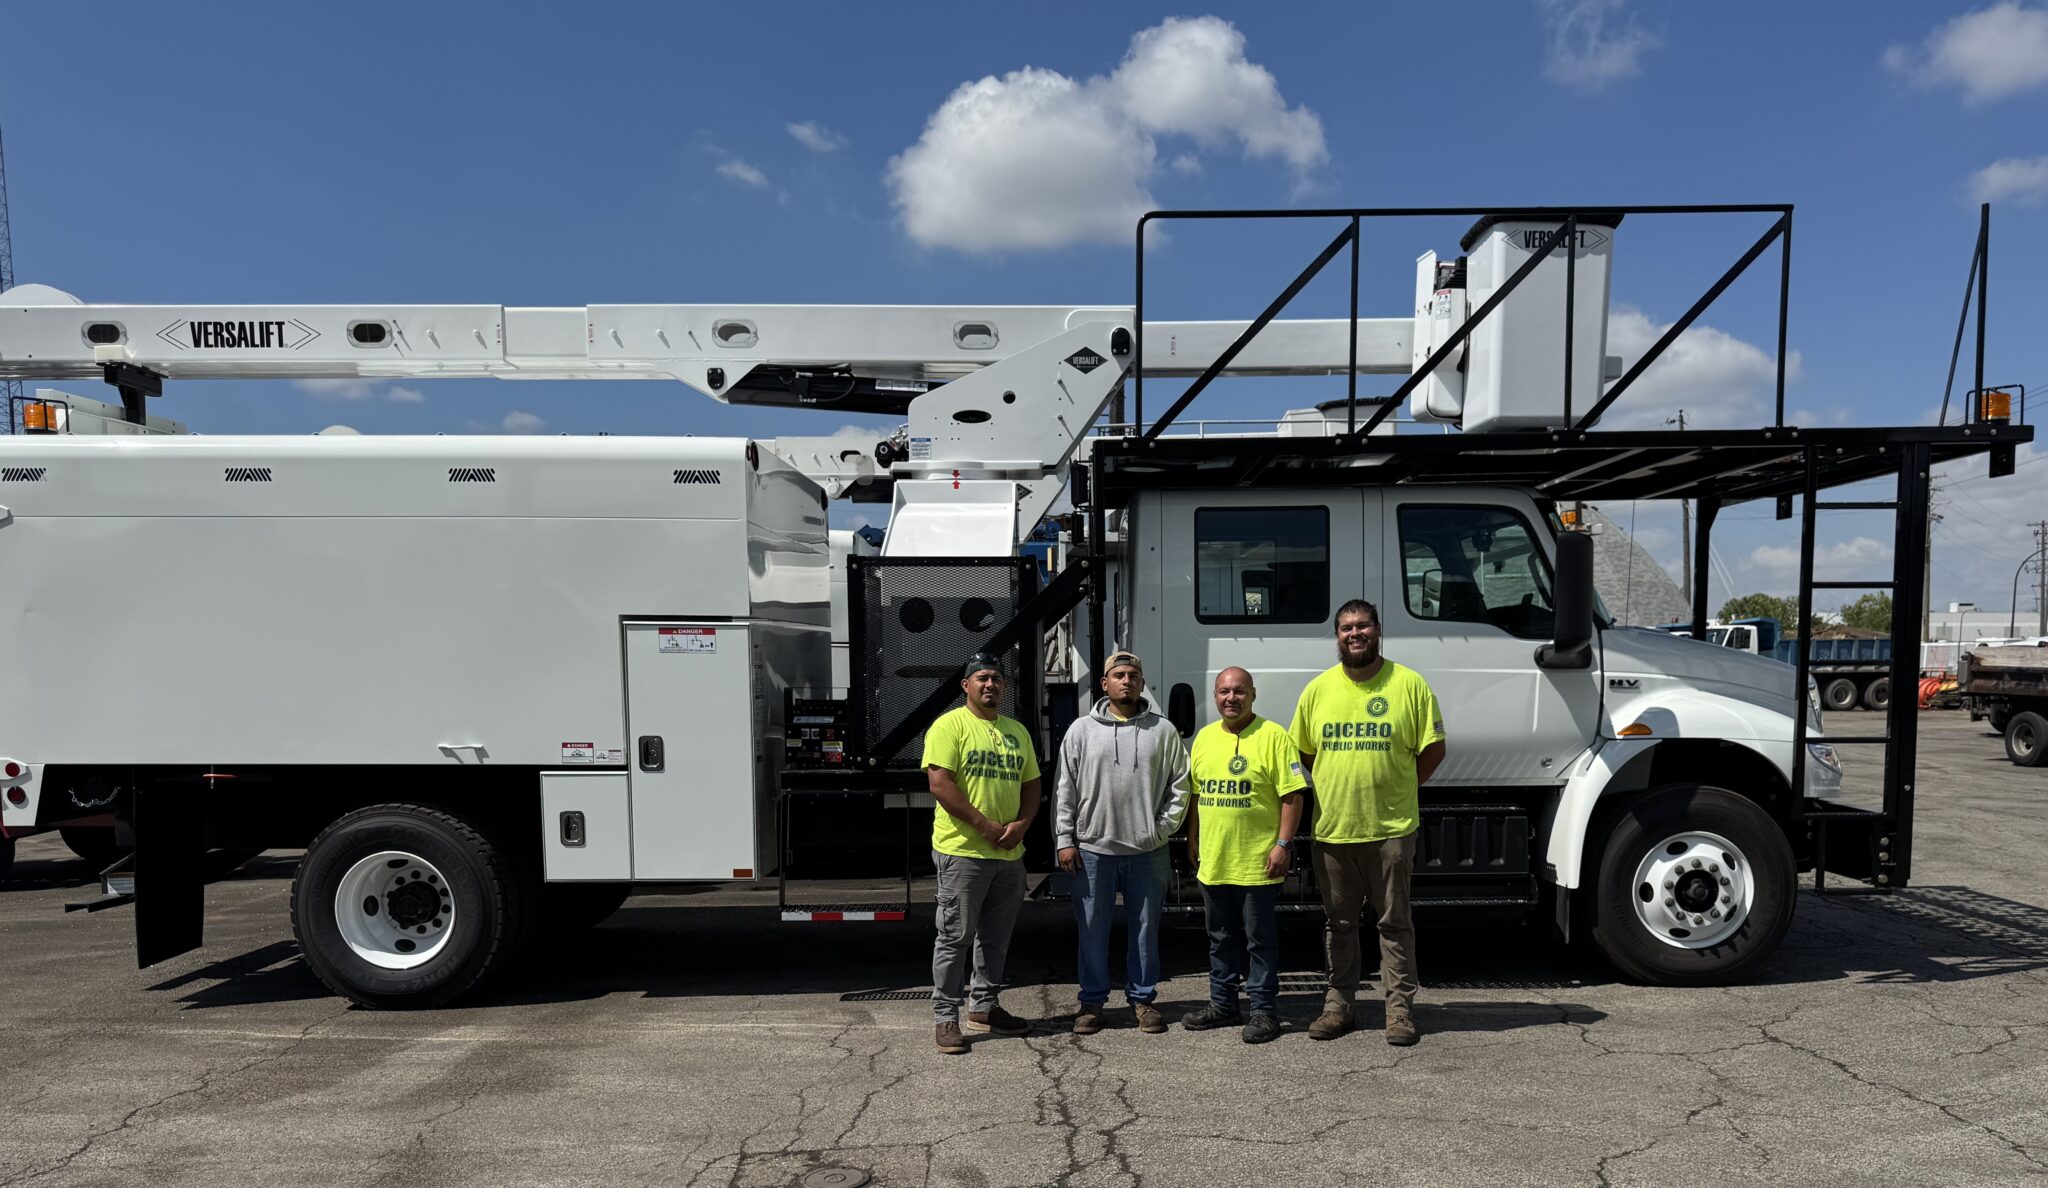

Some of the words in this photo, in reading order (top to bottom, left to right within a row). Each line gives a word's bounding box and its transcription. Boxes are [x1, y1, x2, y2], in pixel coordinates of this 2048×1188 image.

[1524, 230, 1586, 249] VERSLT
[190, 321, 285, 349] VERSALIFT
[1072, 356, 1099, 365] VERSALIFT
[1609, 679, 1640, 687] HV
[1322, 722, 1392, 738] CICERO
[1322, 741, 1353, 751] PUBLIC
[1355, 741, 1391, 751] WORKS
[967, 750, 1024, 770] CICERO
[998, 770, 1020, 782] WORK
[1198, 779, 1251, 795] ICERO
[1199, 796, 1215, 806] BLIC
[1216, 796, 1251, 808] WORKS
